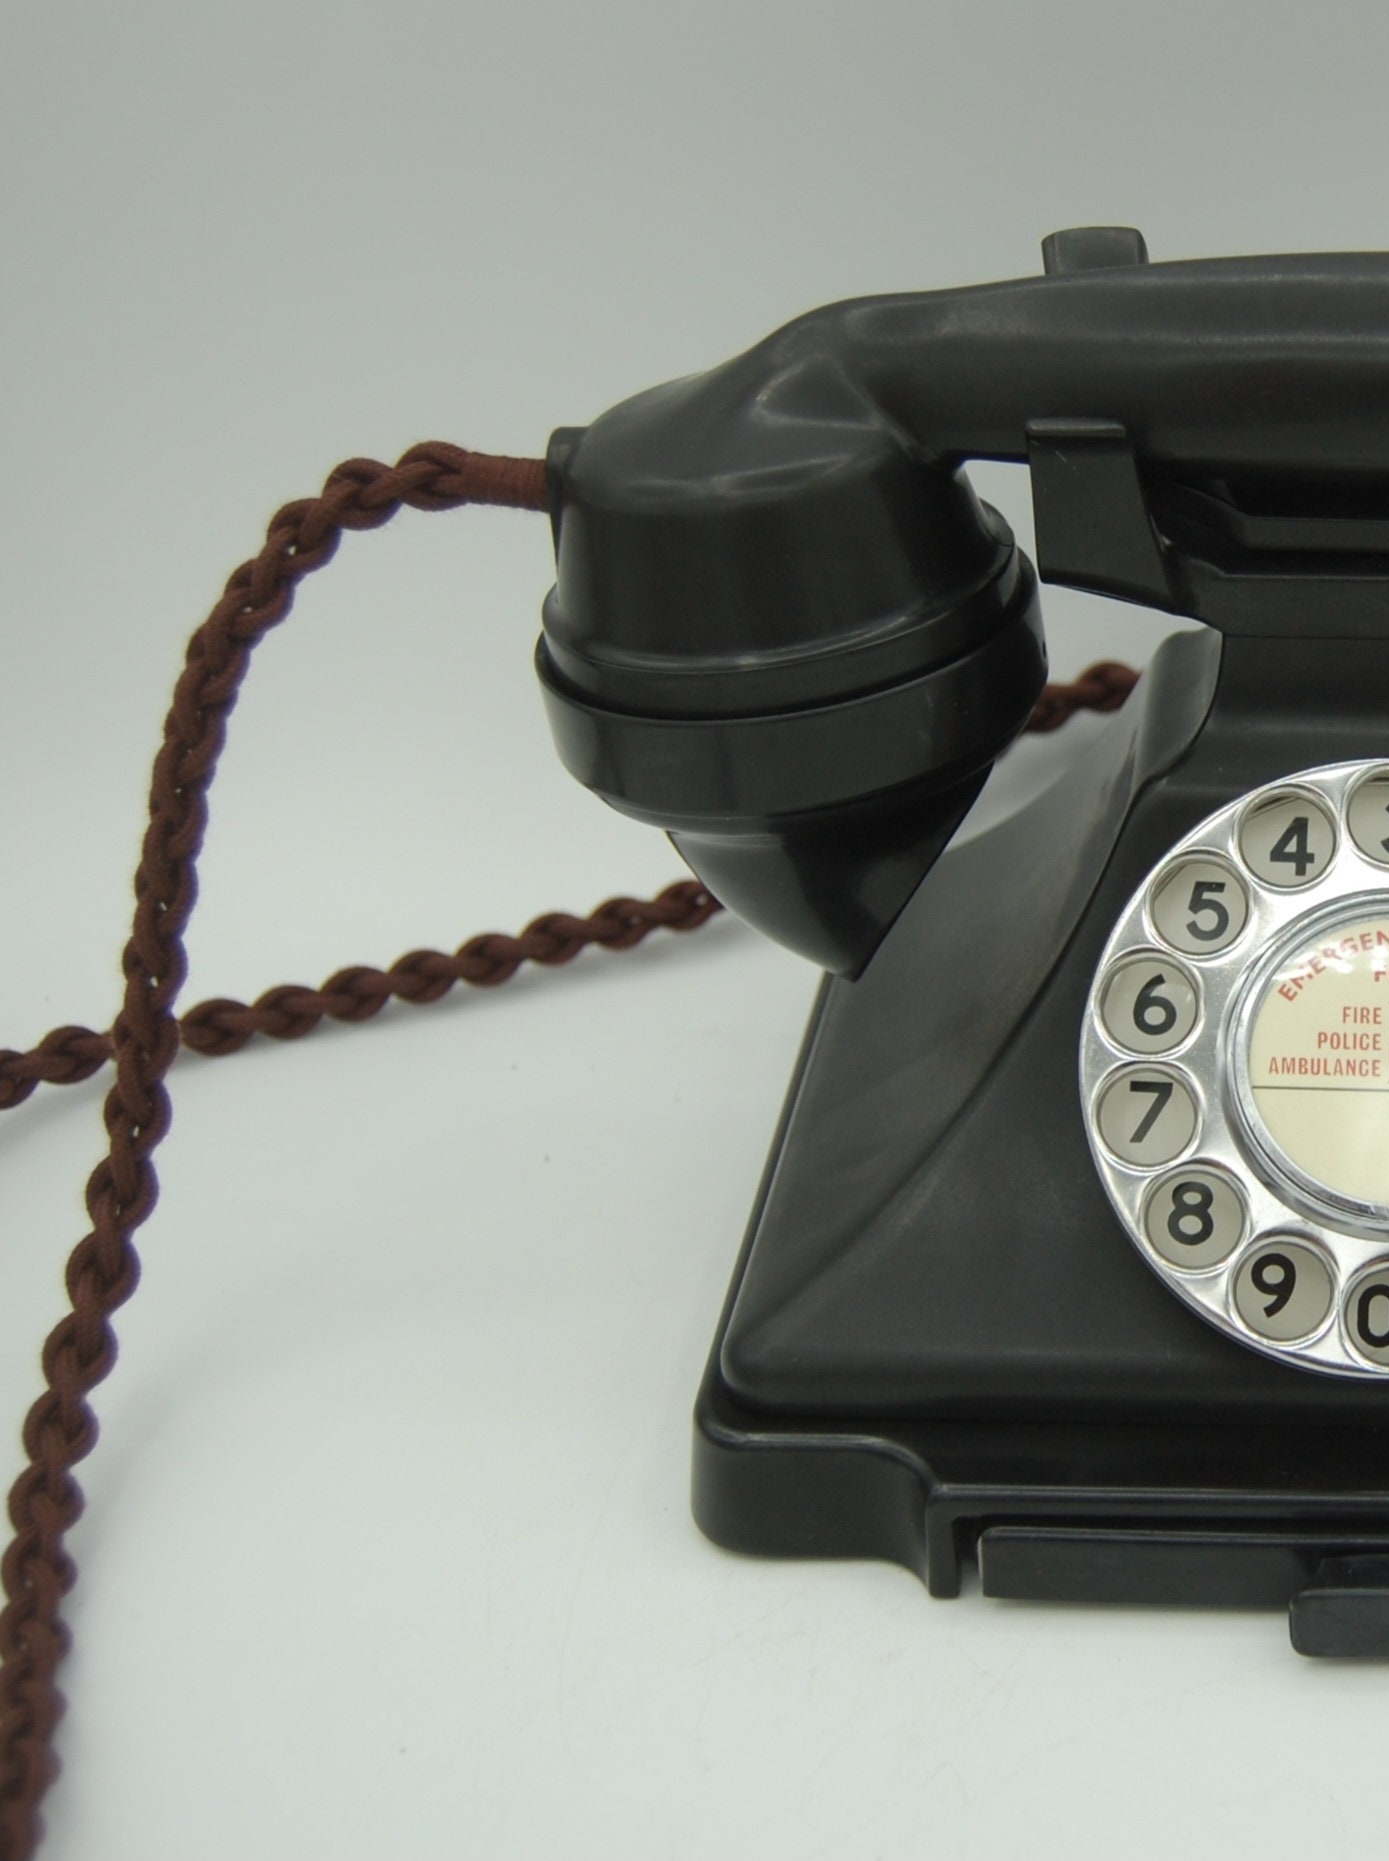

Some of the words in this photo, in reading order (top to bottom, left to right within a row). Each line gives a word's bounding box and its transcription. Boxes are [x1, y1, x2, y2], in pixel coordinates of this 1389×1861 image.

[1269, 816, 1315, 876] 4
[1185, 880, 1229, 941] 5
[1132, 973, 1177, 1036] 6
[1342, 1006, 1383, 1025] FIRE
[1268, 1056, 1382, 1078] AMBULANCE
[1317, 1031, 1382, 1051] POLICE
[1128, 1080, 1174, 1144] 7
[1167, 1180, 1214, 1246] 8
[1250, 1252, 1297, 1319] 9
